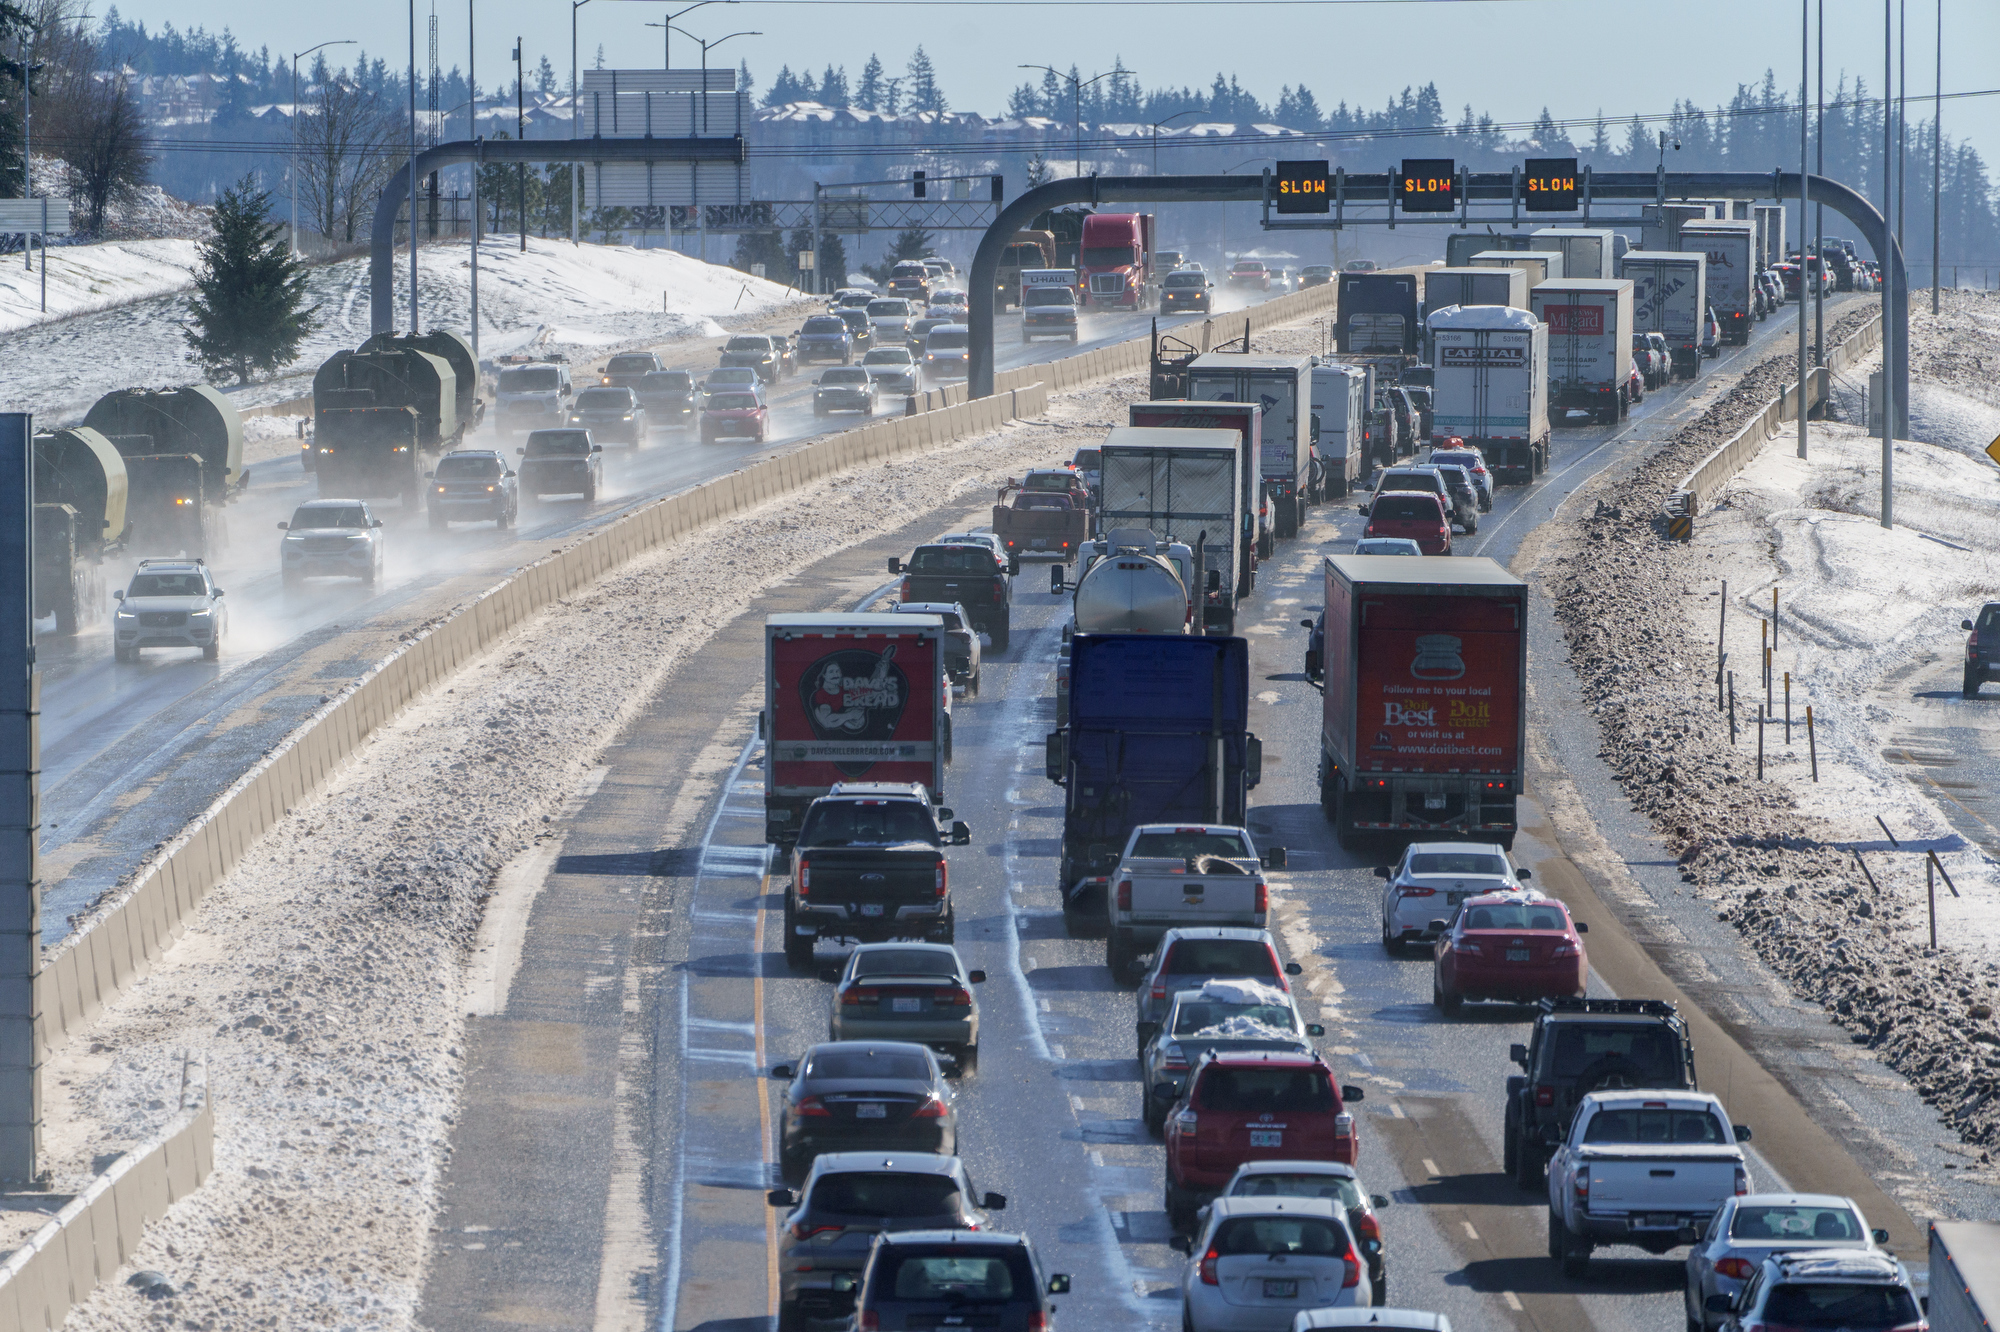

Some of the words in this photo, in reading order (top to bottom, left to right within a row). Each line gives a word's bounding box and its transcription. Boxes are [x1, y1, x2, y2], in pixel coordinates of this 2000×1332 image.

[1280, 179, 1325, 194] SLOW
[1405, 178, 1451, 193] SLOW
[1528, 177, 1574, 192] SLOW
[1444, 348, 1521, 358] CAPITAL
[1434, 417, 1527, 425] www.capitalexpesslines.com
[1383, 685, 1414, 694] Follow
[1445, 688, 1466, 696] your
[1469, 686, 1491, 696] local
[843, 691, 899, 707] BREAD
[1383, 702, 1437, 727] Best
[1448, 718, 1490, 728] center
[1420, 730, 1439, 738] visit
[1455, 731, 1465, 739] at
[811, 747, 895, 756] DAVESKILLERBREAD.COM
[1398, 743, 1502, 755] www.doitbest.com
